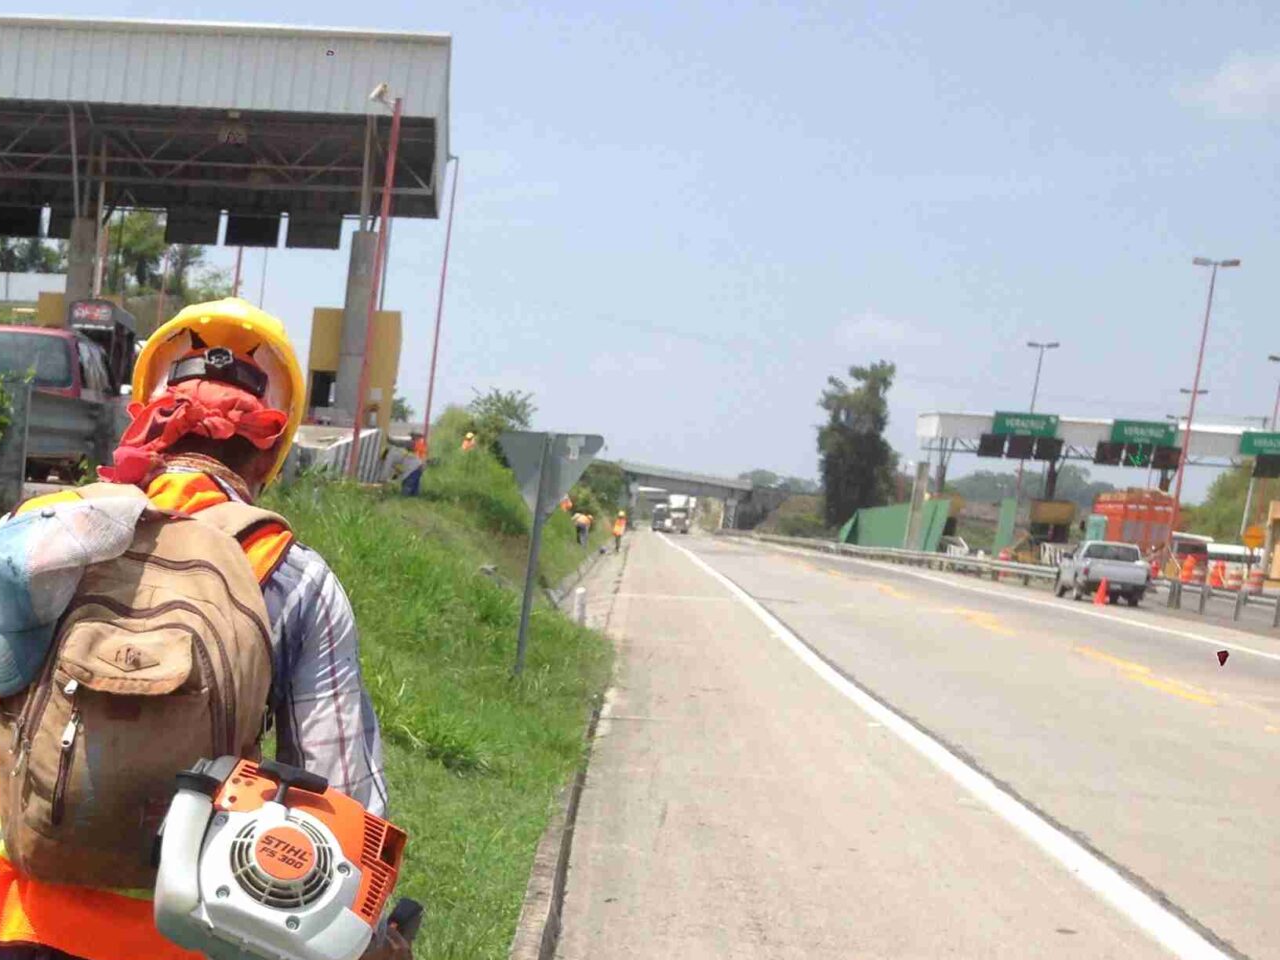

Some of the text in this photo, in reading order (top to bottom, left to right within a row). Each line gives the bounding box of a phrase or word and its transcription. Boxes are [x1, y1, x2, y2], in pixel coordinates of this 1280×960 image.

[259, 846, 304, 869] FS 300
[261, 835, 309, 862] STIHL
